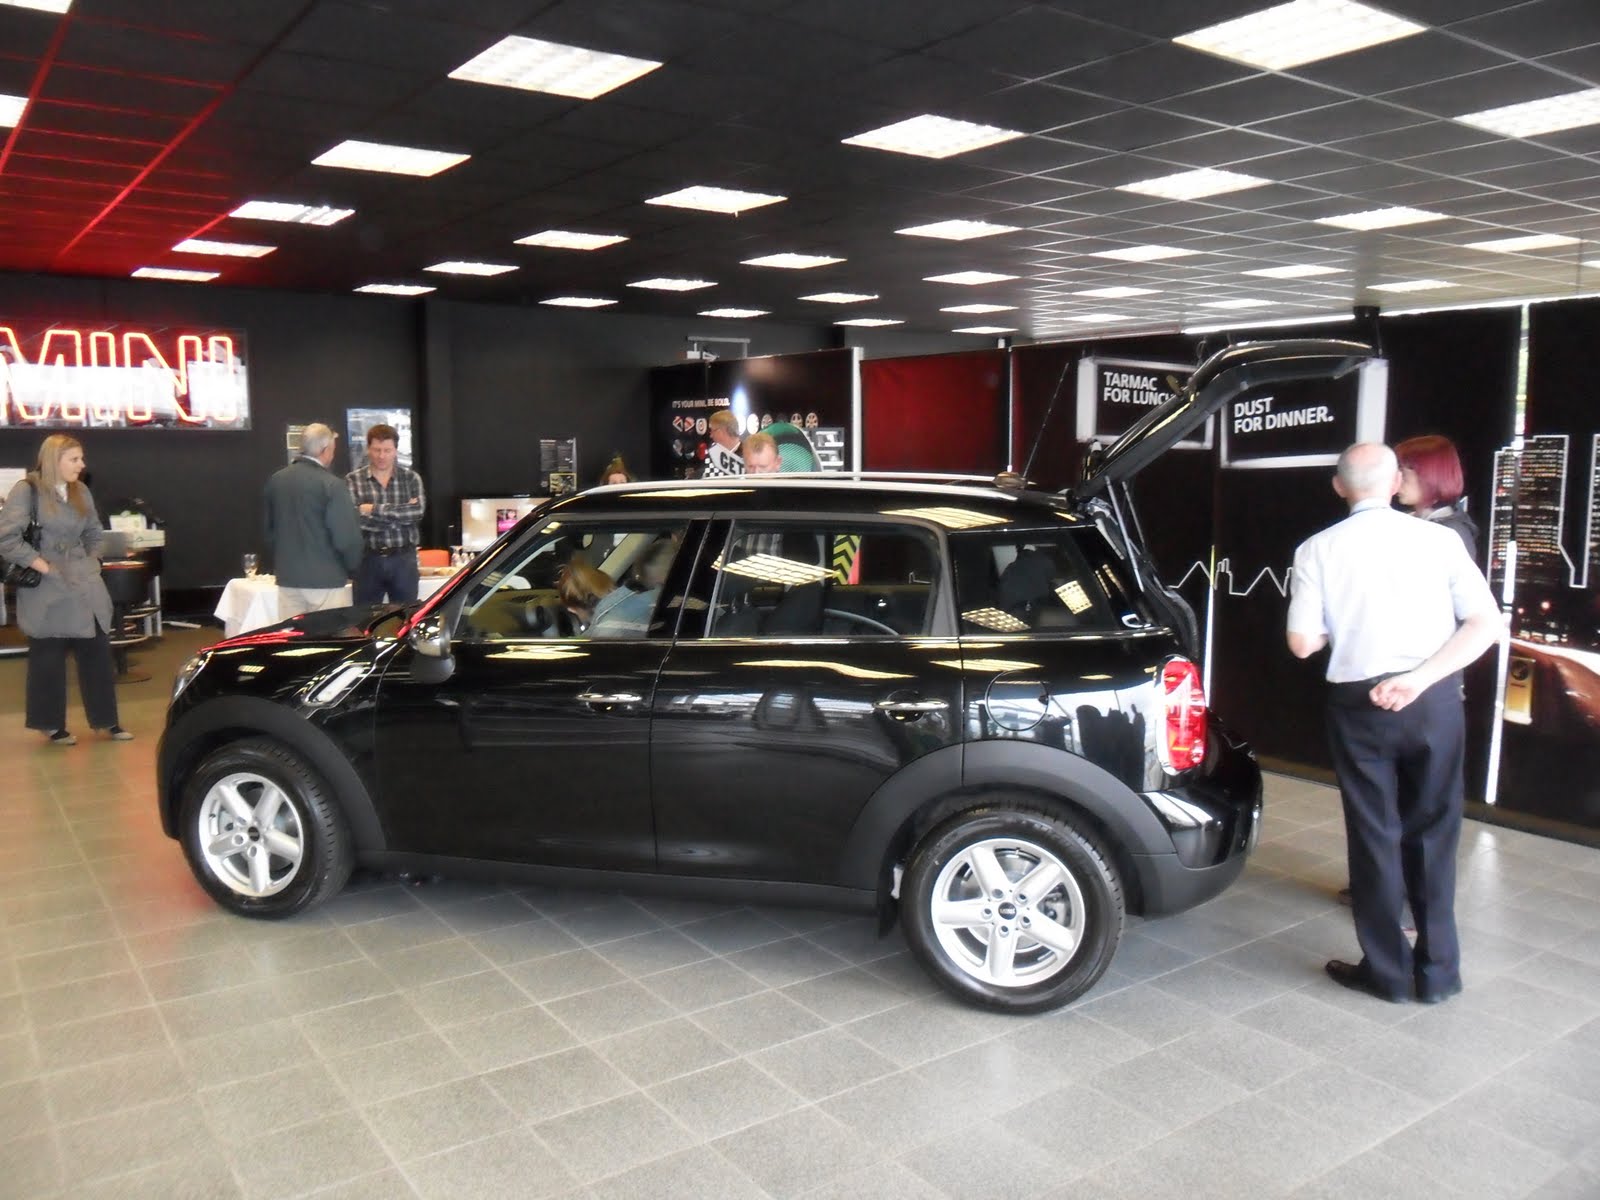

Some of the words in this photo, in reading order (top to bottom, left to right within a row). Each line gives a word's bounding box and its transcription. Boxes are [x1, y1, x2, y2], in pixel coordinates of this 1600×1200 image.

[0, 326, 237, 422] MINI
[1103, 371, 1158, 391] TARMAC
[1103, 387, 1130, 403] FOR
[1234, 396, 1274, 418] DUST
[1234, 416, 1263, 434] FOR
[1265, 405, 1334, 430] DINNER.
